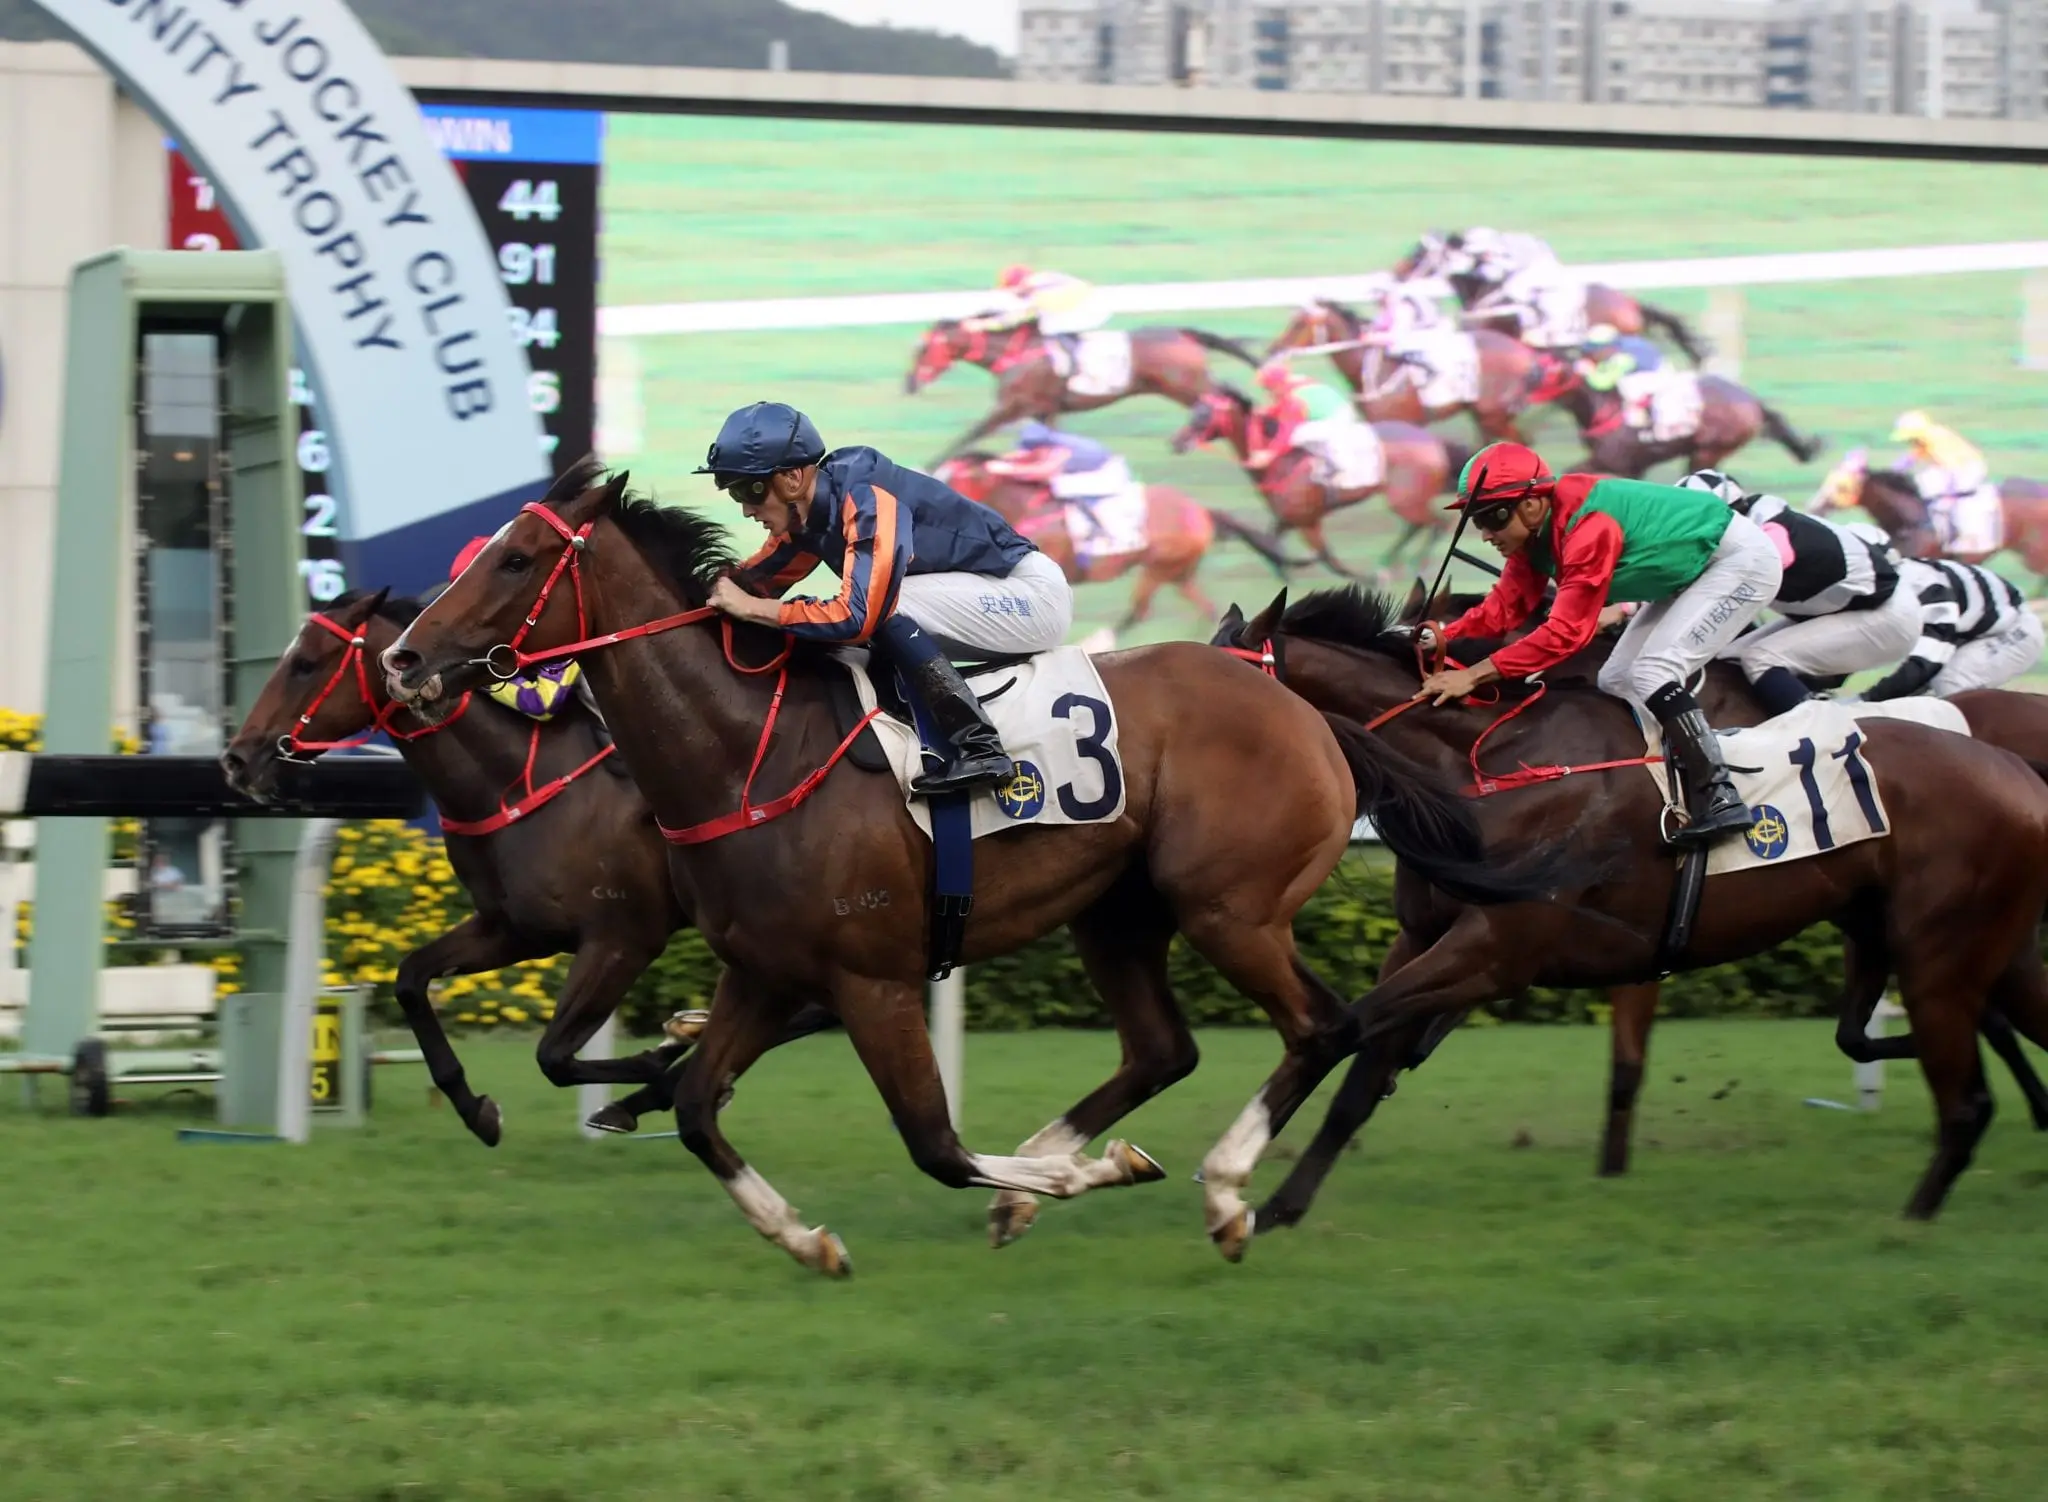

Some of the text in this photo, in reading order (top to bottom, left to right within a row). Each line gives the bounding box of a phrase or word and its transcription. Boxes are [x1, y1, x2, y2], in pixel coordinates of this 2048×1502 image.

[106, 0, 404, 350] NITY TROPHY
[498, 178, 562, 222] 44
[253, 16, 496, 422] JOCKEY CLUB
[499, 241, 557, 286] 91
[296, 429, 331, 473] 6
[300, 494, 338, 537] 2
[1051, 691, 1122, 822] 3
[1789, 731, 1887, 851] 11
